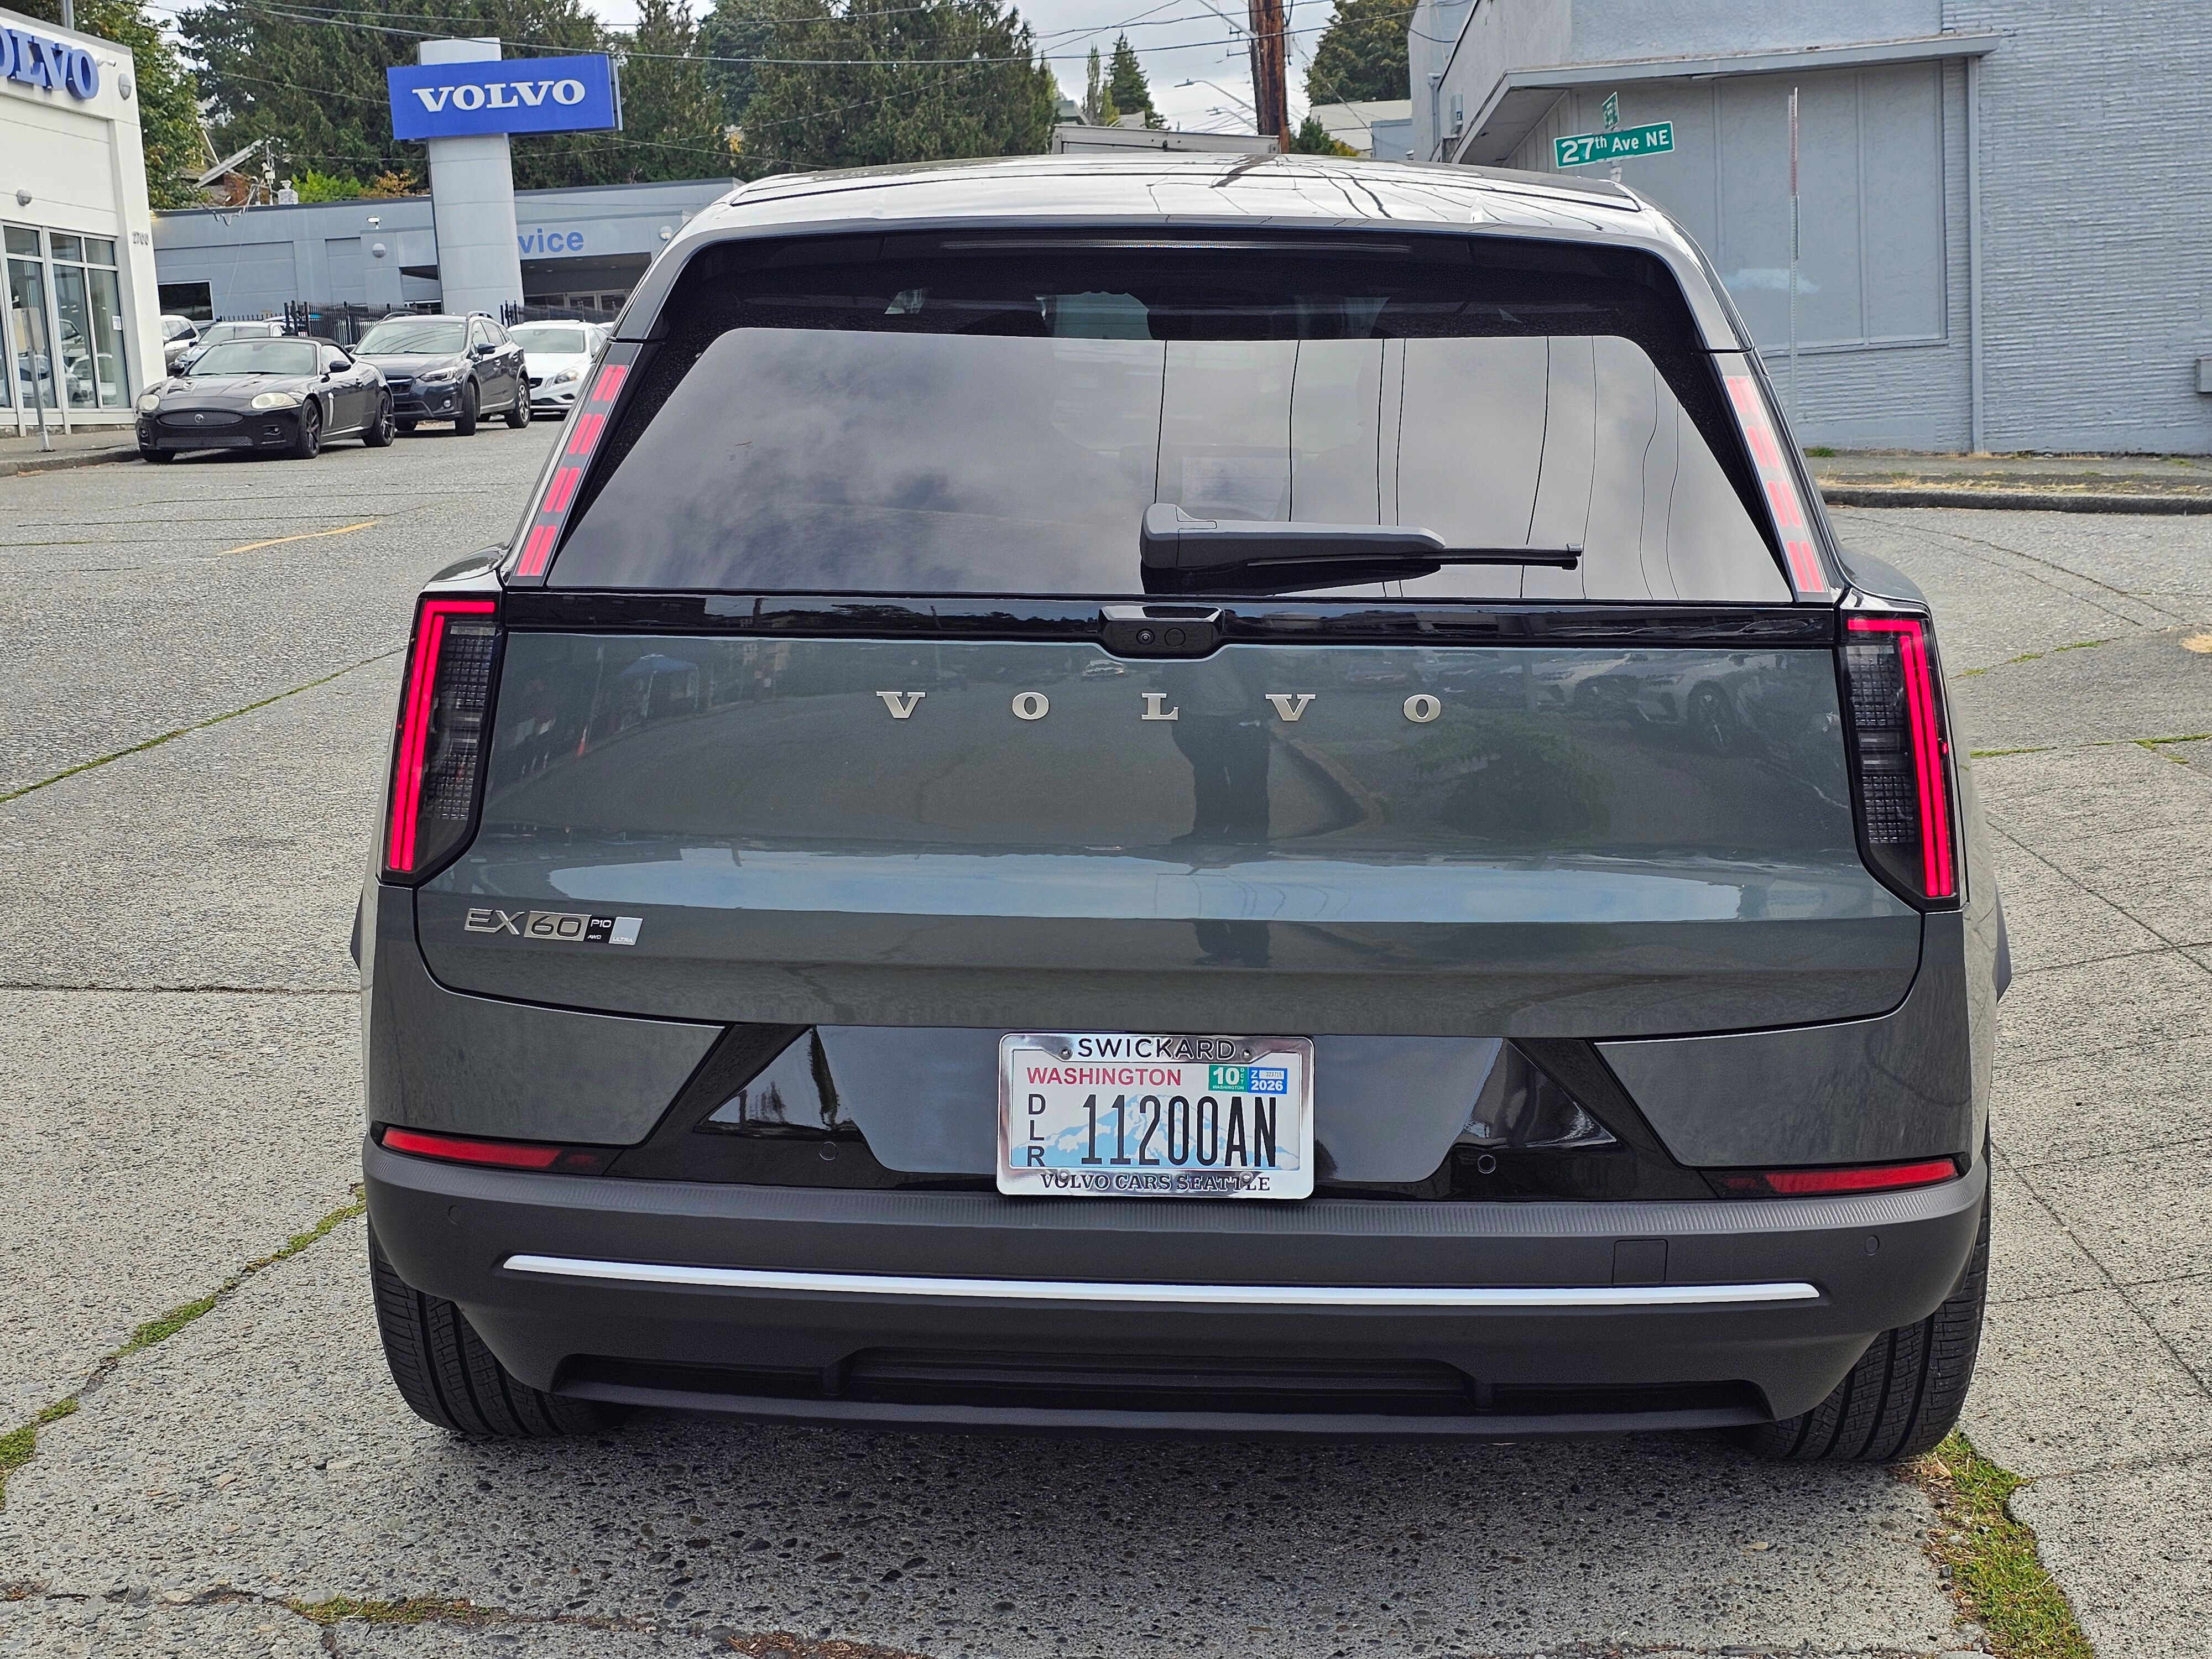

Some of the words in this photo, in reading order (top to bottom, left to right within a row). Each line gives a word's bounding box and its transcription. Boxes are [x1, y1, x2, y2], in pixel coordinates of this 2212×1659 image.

[412, 80, 586, 112] VOLVO
[1561, 135, 1607, 163] 27th
[1611, 137, 1639, 153] Ave
[1646, 129, 1670, 147] NE
[876, 691, 1442, 723] VOLVO
[590, 919, 612, 928] P10
[1077, 1037, 1237, 1060] SWICKARD
[1026, 1067, 1181, 1086] WASHINGTON
[1213, 1067, 1240, 1085] 10
[1251, 1070, 1259, 1079] Z
[1251, 1079, 1284, 1091] 2026
[1081, 1094, 1276, 1167] 11200AN
[1040, 1172, 1111, 1190] VOLVO
[1115, 1175, 1173, 1192] CARS
[1176, 1175, 1271, 1192] SEATTLE
